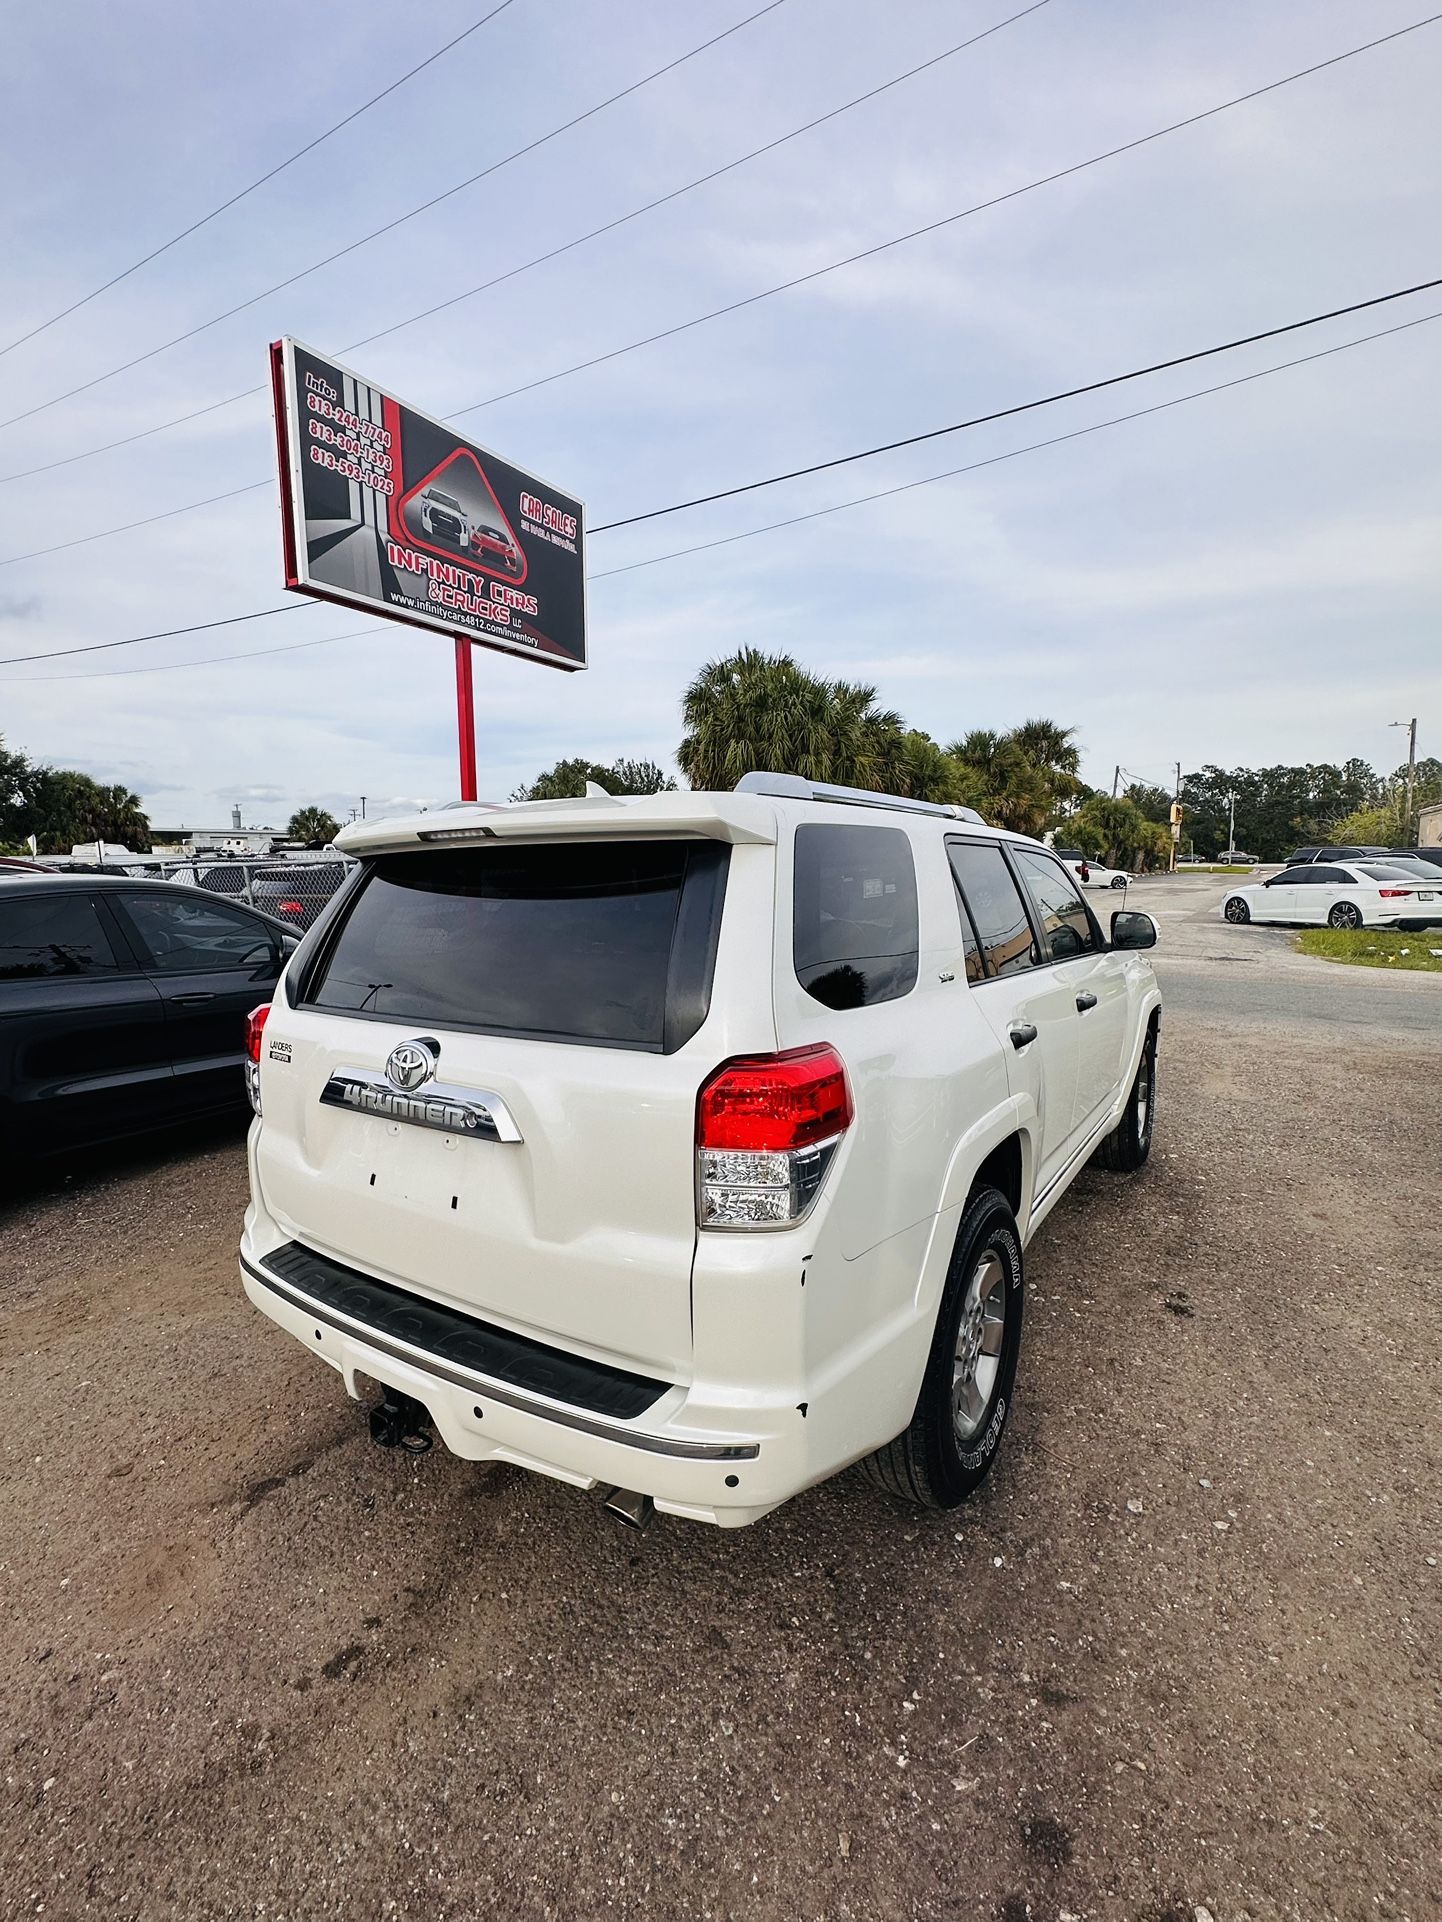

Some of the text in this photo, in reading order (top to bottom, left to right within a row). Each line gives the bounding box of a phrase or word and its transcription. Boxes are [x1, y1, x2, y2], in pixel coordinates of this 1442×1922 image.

[306, 372, 337, 401] Info:
[307, 392, 391, 448] 813-244-7744
[309, 418, 393, 472] 813-304-1393
[310, 445, 394, 496] 813-593-1025
[520, 491, 577, 540] CAR SALES
[387, 541, 538, 616] INFINITY CARS
[390, 591, 539, 648] www.infinitycars4812.com/inventory
[512, 617, 522, 629] LLC
